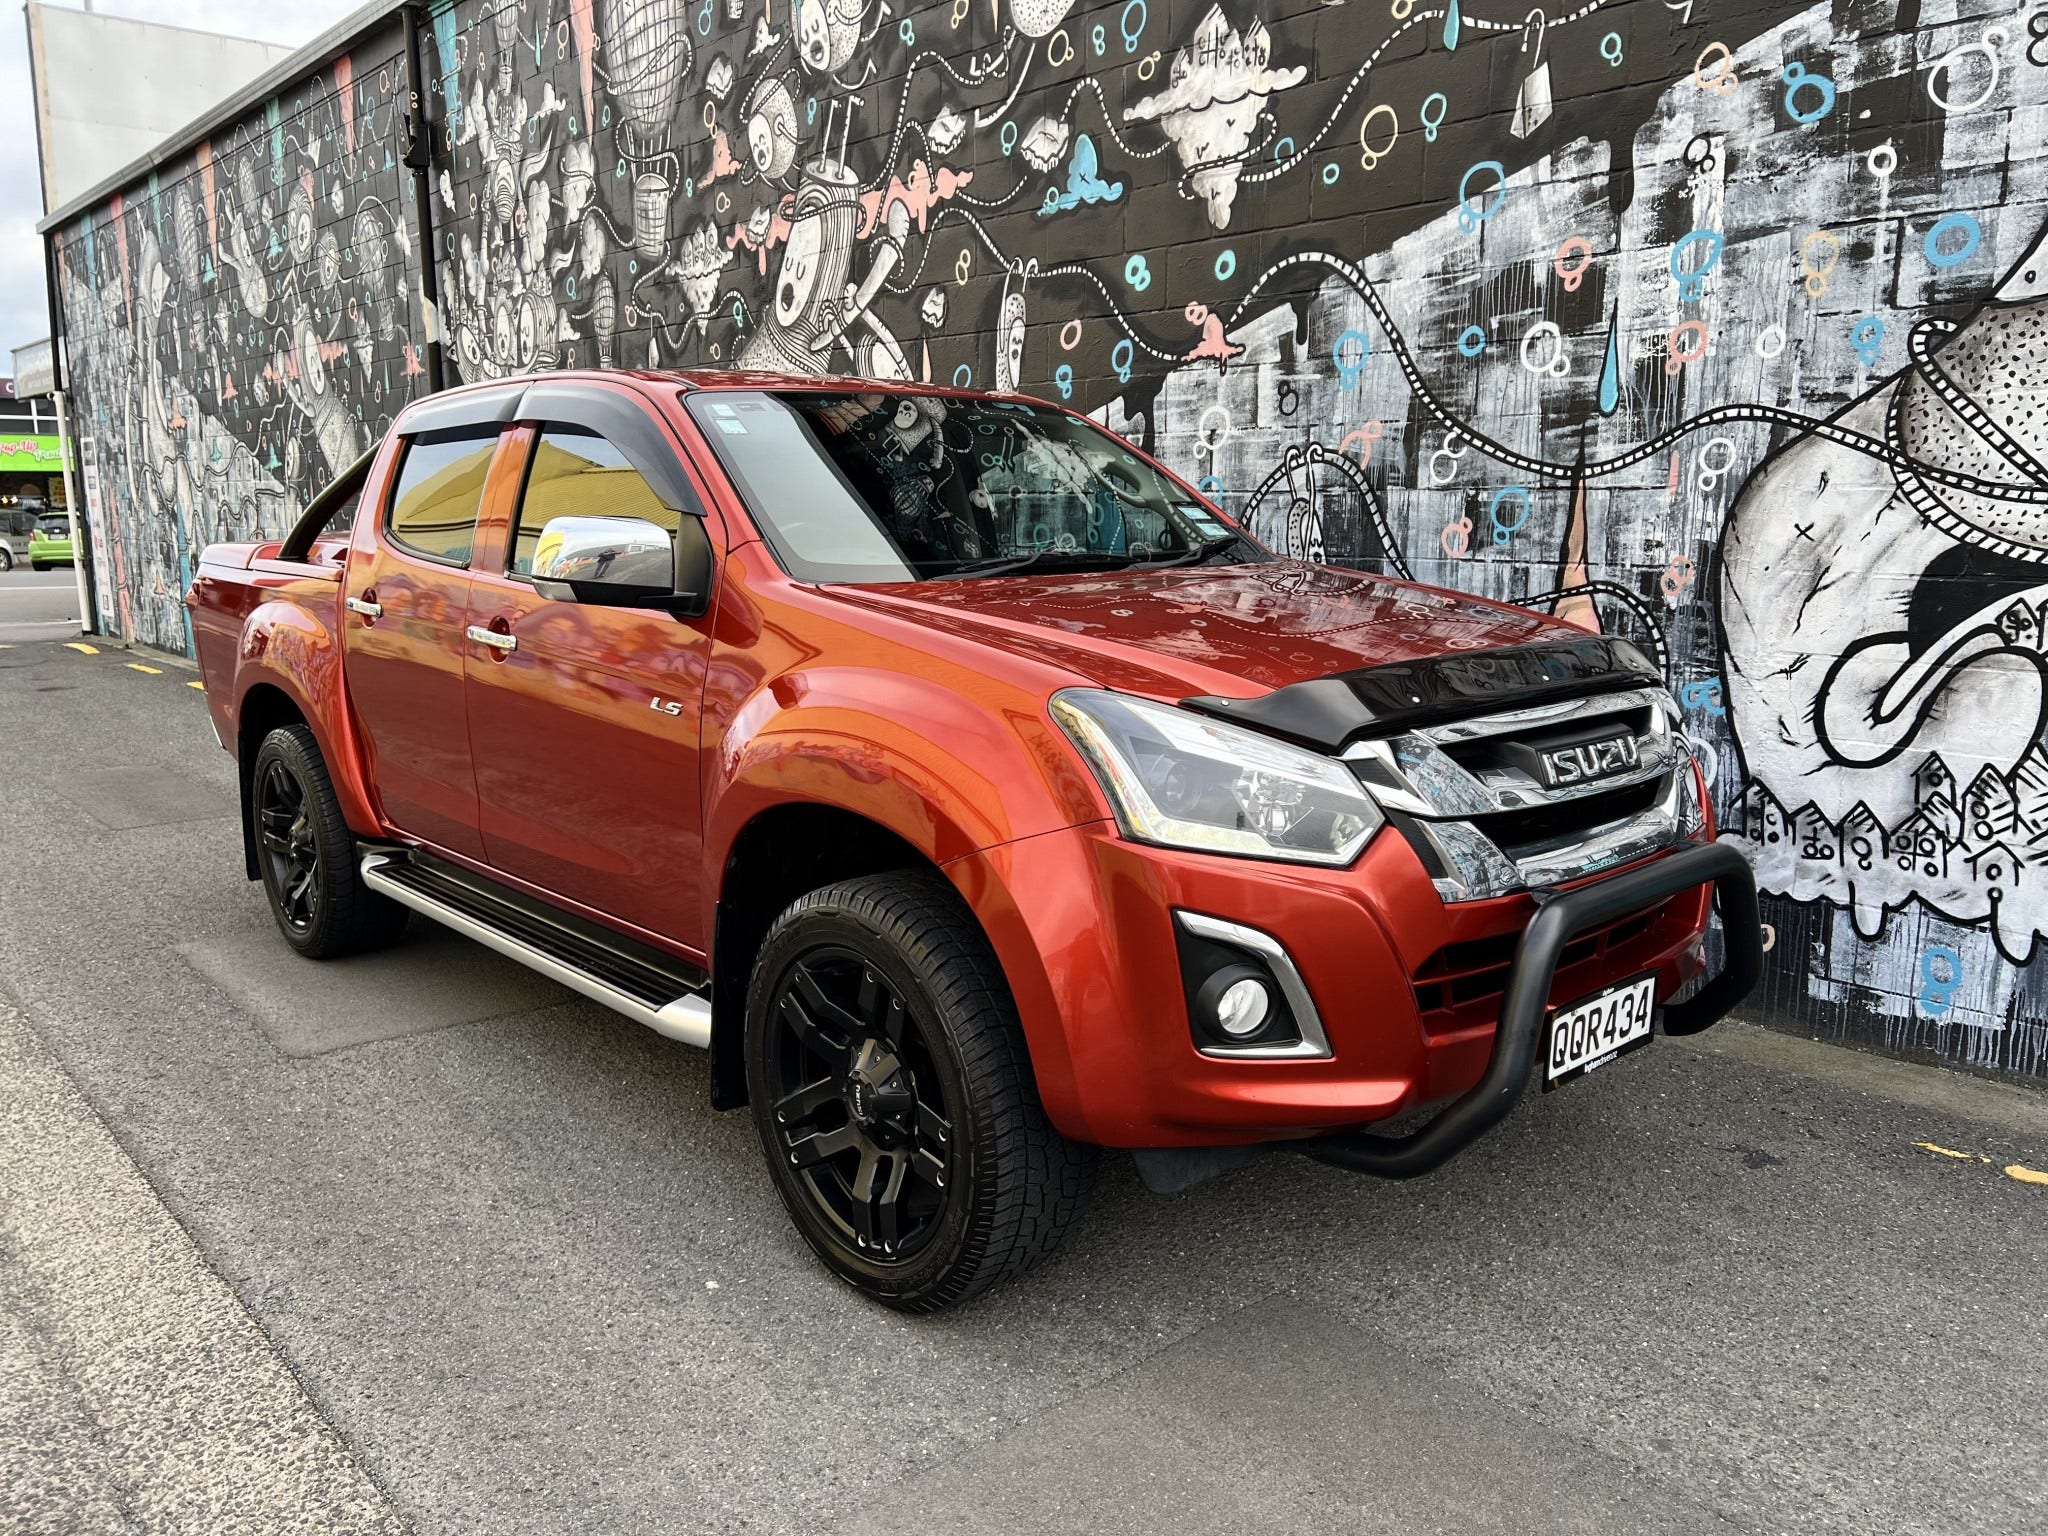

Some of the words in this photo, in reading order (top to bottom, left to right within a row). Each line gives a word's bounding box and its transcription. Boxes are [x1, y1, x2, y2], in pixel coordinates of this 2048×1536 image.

[650, 696, 684, 716] LS
[1542, 735, 1638, 785] ISUZU
[1552, 985, 1650, 1069] QQR434
